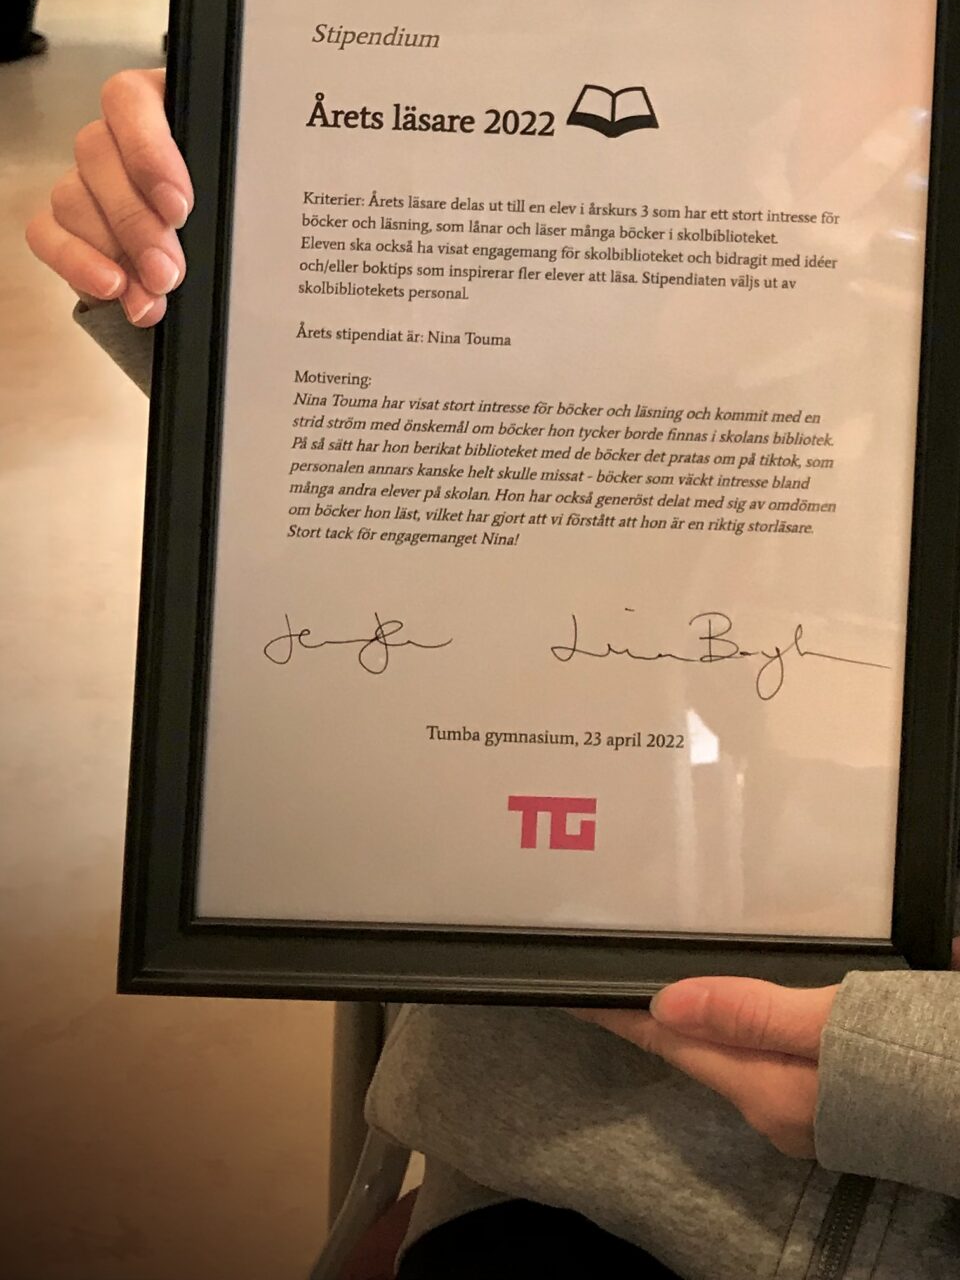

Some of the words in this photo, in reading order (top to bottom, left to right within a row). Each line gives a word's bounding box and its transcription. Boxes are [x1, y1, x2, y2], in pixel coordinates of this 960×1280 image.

[311, 23, 441, 51] Stipendium
[305, 91, 385, 131] Årets
[391, 102, 477, 134] läsare
[482, 108, 556, 138] 2022
[302, 191, 366, 208] Kriterier:
[367, 189, 405, 209] Årets
[407, 194, 448, 211] läsare
[450, 196, 485, 212] delas
[488, 200, 504, 213] ut
[506, 198, 526, 214] till
[528, 203, 546, 214] en
[548, 200, 578, 215] elev
[579, 202, 585, 216] i
[587, 201, 638, 218] årskurs
[639, 204, 649, 218] 3
[651, 208, 681, 219] som
[683, 205, 708, 220] har
[709, 208, 730, 221] ett
[731, 209, 764, 222] stort
[766, 209, 818, 224] intresse
[820, 210, 841, 225] för
[301, 212, 350, 229] böcker
[351, 215, 377, 230] och
[379, 216, 433, 236] läsning,
[435, 222, 465, 233] som
[467, 218, 504, 235] lånar
[506, 221, 532, 236] och
[534, 221, 568, 237] läser
[569, 223, 616, 243] många
[618, 224, 667, 241] böcker
[668, 227, 674, 241] i
[300, 235, 346, 253] Eleven
[349, 236, 373, 252] ska
[374, 237, 414, 254] också
[415, 239, 434, 255] ha
[436, 241, 470, 256] visat
[471, 245, 559, 264] engagemang
[560, 244, 582, 260] för
[583, 245, 685, 264] skolbiblioteket
[686, 250, 713, 265] och
[715, 249, 769, 270] bidragit
[769, 253, 802, 268] med
[803, 253, 839, 270] idéer
[298, 279, 406, 298] skolbibliotekets
[299, 257, 360, 276] och/eller
[361, 259, 414, 280] boktips
[416, 265, 445, 278] som
[447, 263, 516, 283] inspirerar
[517, 265, 543, 281] fler
[544, 266, 586, 283] elever
[587, 271, 608, 283] att
[641, 270, 727, 289] Stipendiaten
[729, 273, 761, 292] väljs
[763, 277, 779, 289] ut
[780, 279, 797, 290] av
[295, 320, 333, 340] Årets
[335, 327, 404, 345] stipendiat
[406, 329, 425, 344] är:
[426, 330, 461, 345] Nina
[463, 331, 512, 347] Touma
[293, 369, 372, 391] Motivering:
[292, 391, 328, 408] Nina
[330, 392, 379, 410] Touma
[379, 394, 406, 411] har
[408, 397, 441, 412] visat
[441, 399, 477, 413] stort
[475, 399, 531, 415] intresse
[531, 400, 555, 416] för
[555, 401, 605, 417] böcker
[605, 403, 632, 418] och
[633, 403, 685, 424] läsning
[685, 405, 712, 421] och
[713, 406, 770, 423] kommit
[770, 409, 803, 424] med
[803, 413, 821, 425] en
[291, 414, 326, 429] strid
[325, 416, 367, 431] ström
[369, 417, 402, 433] med
[402, 417, 471, 435] önskemål
[471, 424, 495, 436] om
[497, 420, 546, 437] böcker
[546, 422, 576, 438] hon
[578, 424, 623, 443] tycker
[623, 425, 665, 441] borde
[665, 427, 709, 443] finnas
[709, 429, 718, 443] i
[718, 428, 770, 445] skolans
[772, 431, 835, 447] bibliotek.
[287, 459, 365, 476] personalen
[367, 464, 415, 477] annars
[415, 462, 465, 479] kanske
[466, 464, 496, 480] helt
[495, 465, 538, 481] skulle
[539, 468, 585, 483] missat
[595, 468, 644, 485] böcker
[644, 474, 675, 486] som
[678, 472, 715, 487] väckt
[715, 473, 770, 489] intresse
[771, 474, 812, 490] bland
[288, 480, 335, 500] många
[337, 482, 378, 497] andra
[379, 482, 423, 499] elever
[421, 484, 443, 504] på
[443, 485, 491, 502] skolan.
[493, 487, 526, 503] Hon
[527, 488, 554, 504] har
[554, 489, 594, 505] också
[593, 492, 656, 510] generöst
[656, 492, 692, 508] delat
[692, 494, 726, 510] med
[725, 496, 748, 514] sig
[748, 499, 767, 511] av
[767, 497, 837, 513] omdömen
[286, 523, 323, 539] Stort
[324, 525, 355, 541] tack
[355, 526, 378, 541] för
[379, 529, 479, 548] engagemanget
[480, 530, 521, 547] Nina!
[425, 724, 481, 742] Tumba
[483, 729, 580, 748] gymnasium,
[583, 730, 602, 747] 23
[605, 731, 642, 752] april
[645, 733, 685, 749] 2022
[508, 796, 597, 851] TG
